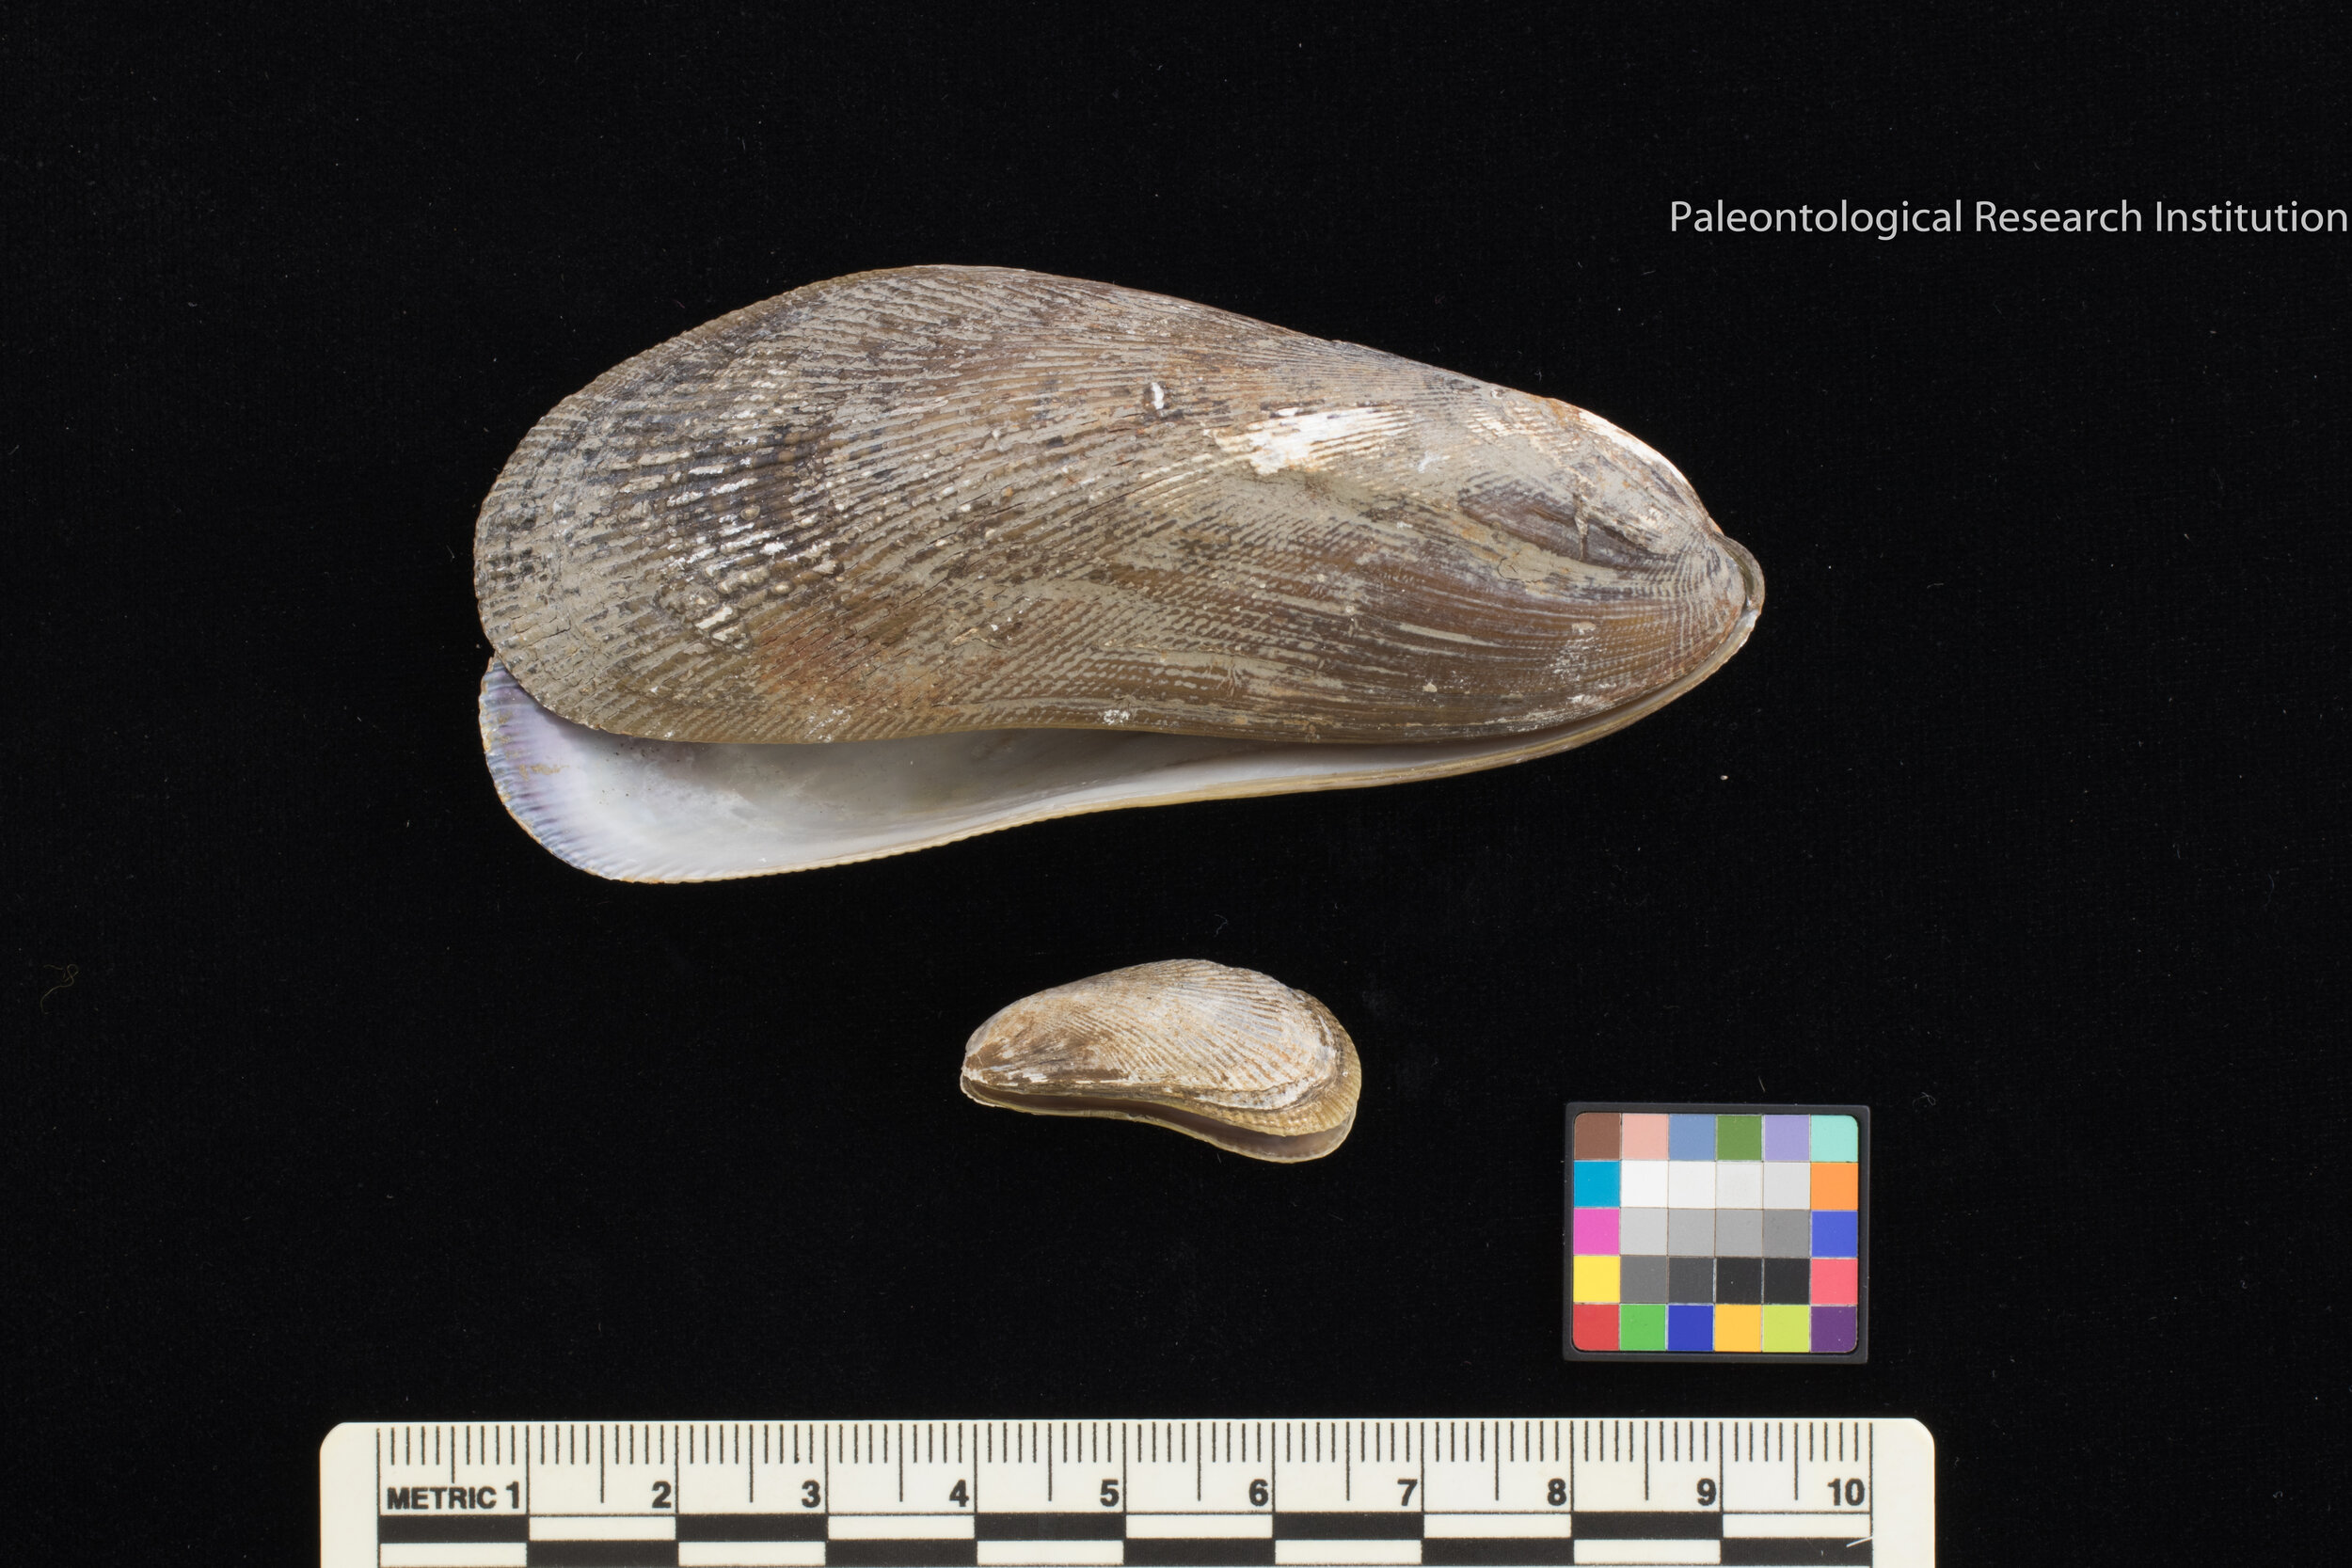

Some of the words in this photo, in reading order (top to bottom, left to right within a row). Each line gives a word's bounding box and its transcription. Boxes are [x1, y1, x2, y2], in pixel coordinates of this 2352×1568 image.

[387, 1486, 497, 1510] METRIC
[505, 1481, 519, 1510] 1
[652, 1481, 672, 1509] 2
[802, 1480, 821, 1509] 3
[949, 1479, 970, 1508] 4
[1100, 1479, 1120, 1508] 5
[1248, 1479, 1269, 1507] 6
[1397, 1479, 1418, 1507] 7
[1547, 1478, 1567, 1507] 8
[1696, 1478, 1717, 1507] 9
[1827, 1478, 1866, 1507] 10
